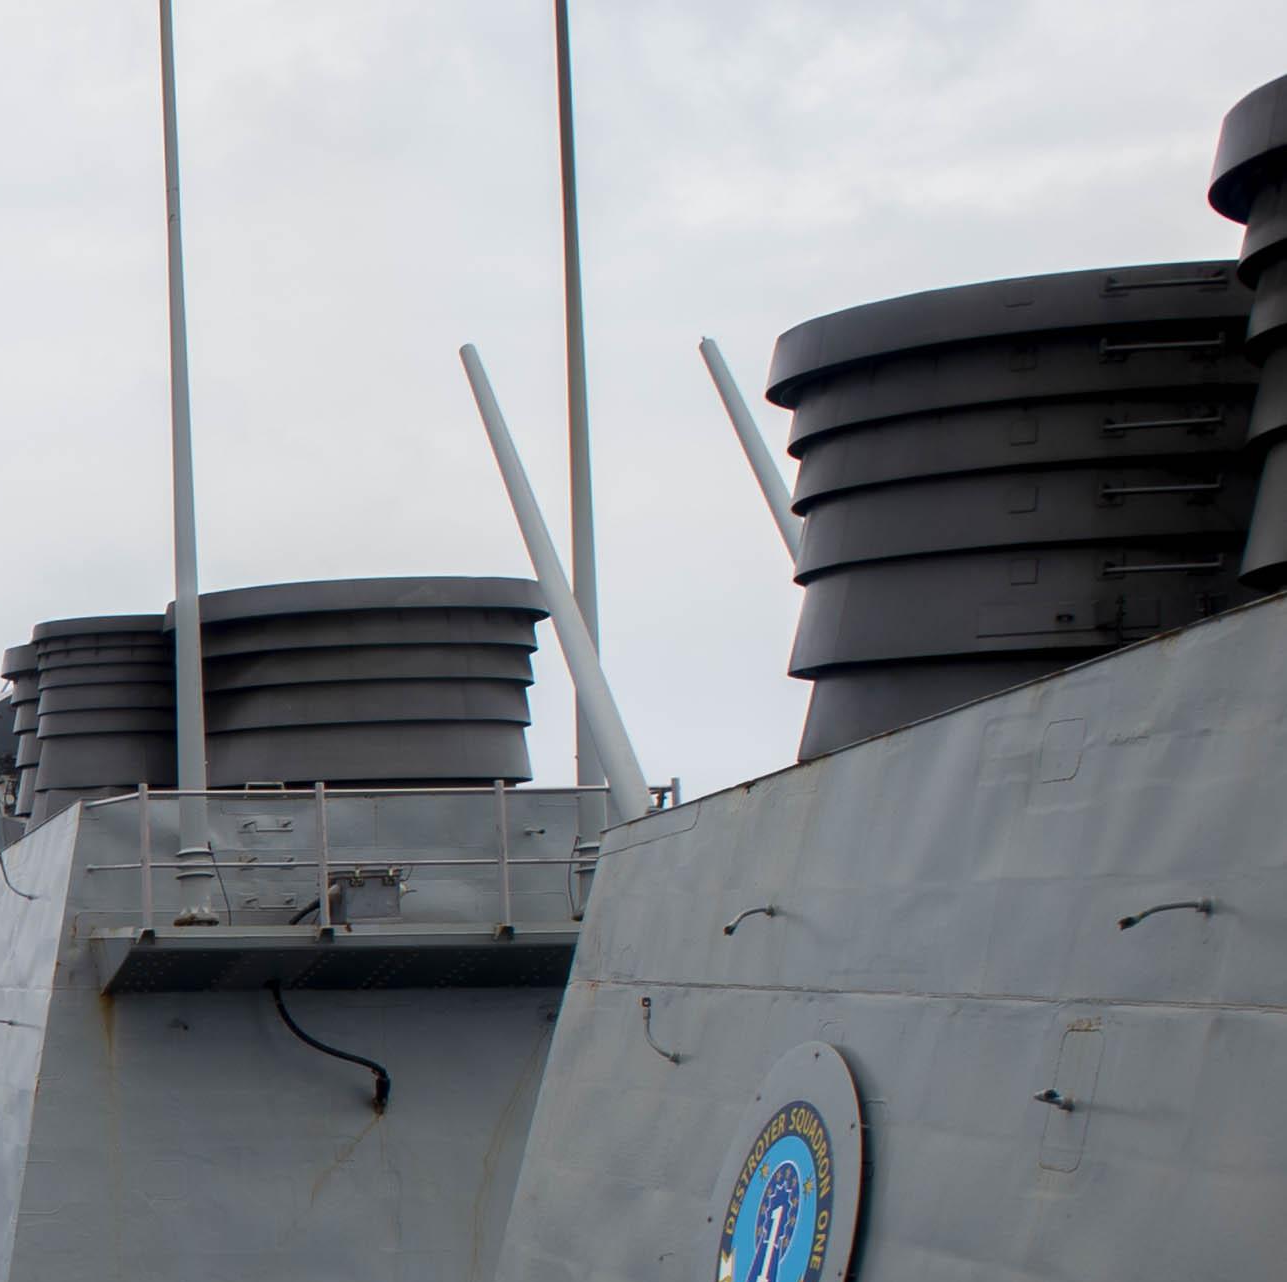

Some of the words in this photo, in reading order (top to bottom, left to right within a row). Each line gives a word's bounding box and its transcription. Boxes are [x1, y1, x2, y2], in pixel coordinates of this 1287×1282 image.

[725, 1114, 787, 1235] DESTROYER
[788, 1108, 831, 1198] SQUADRON
[810, 1210, 830, 1271] ONE
